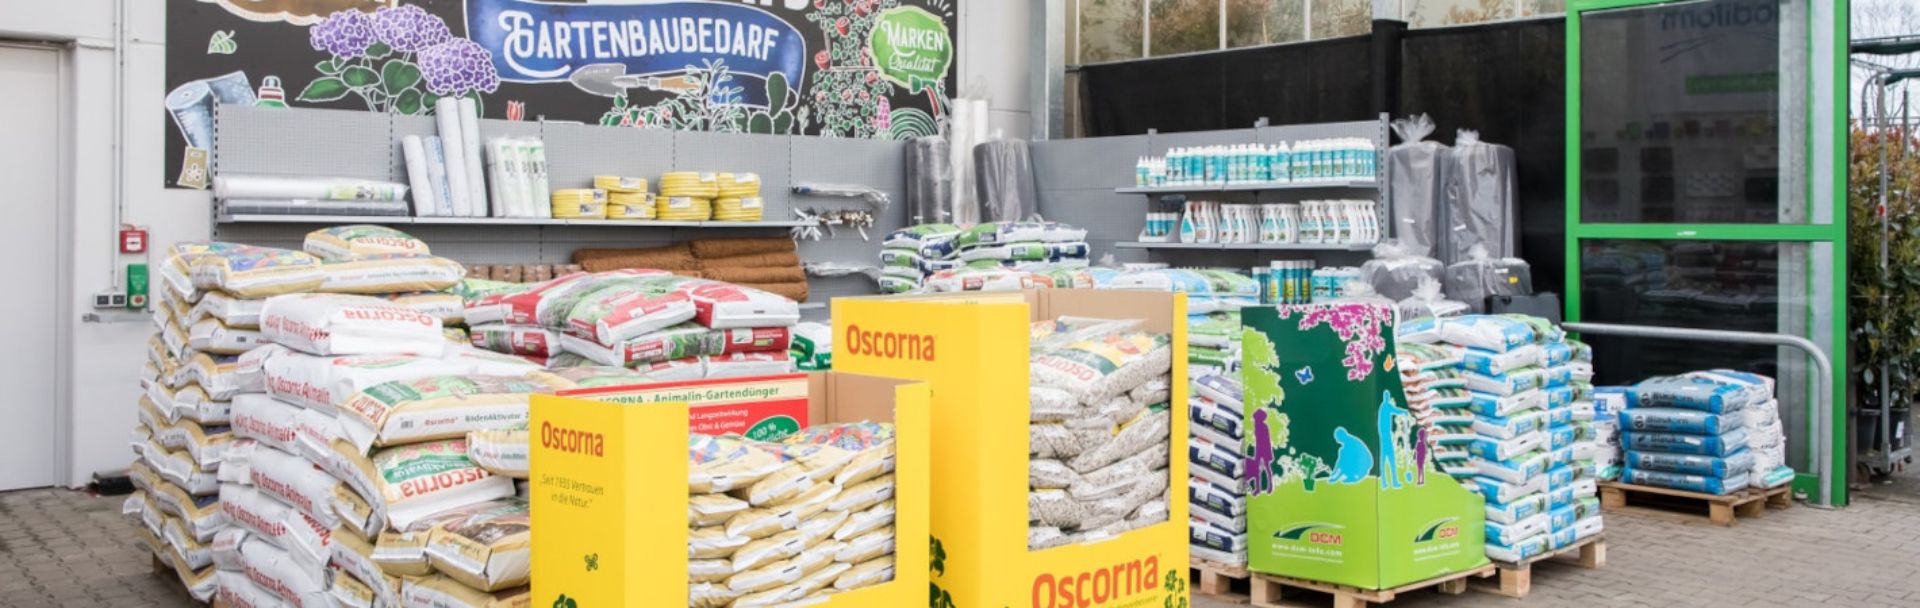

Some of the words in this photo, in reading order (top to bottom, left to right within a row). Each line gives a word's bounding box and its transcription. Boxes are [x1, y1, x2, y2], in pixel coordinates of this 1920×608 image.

[498, 10, 780, 77] GARTENBAUBEDARF
[880, 20, 944, 56] MARKEN
[889, 52, 941, 73] Qualität
[344, 309, 434, 327] Oscorna
[846, 324, 935, 362] Oscorna
[541, 420, 604, 458] Oscorna
[1309, 532, 1342, 544] DCM
[1032, 554, 1159, 608] Oscorna
